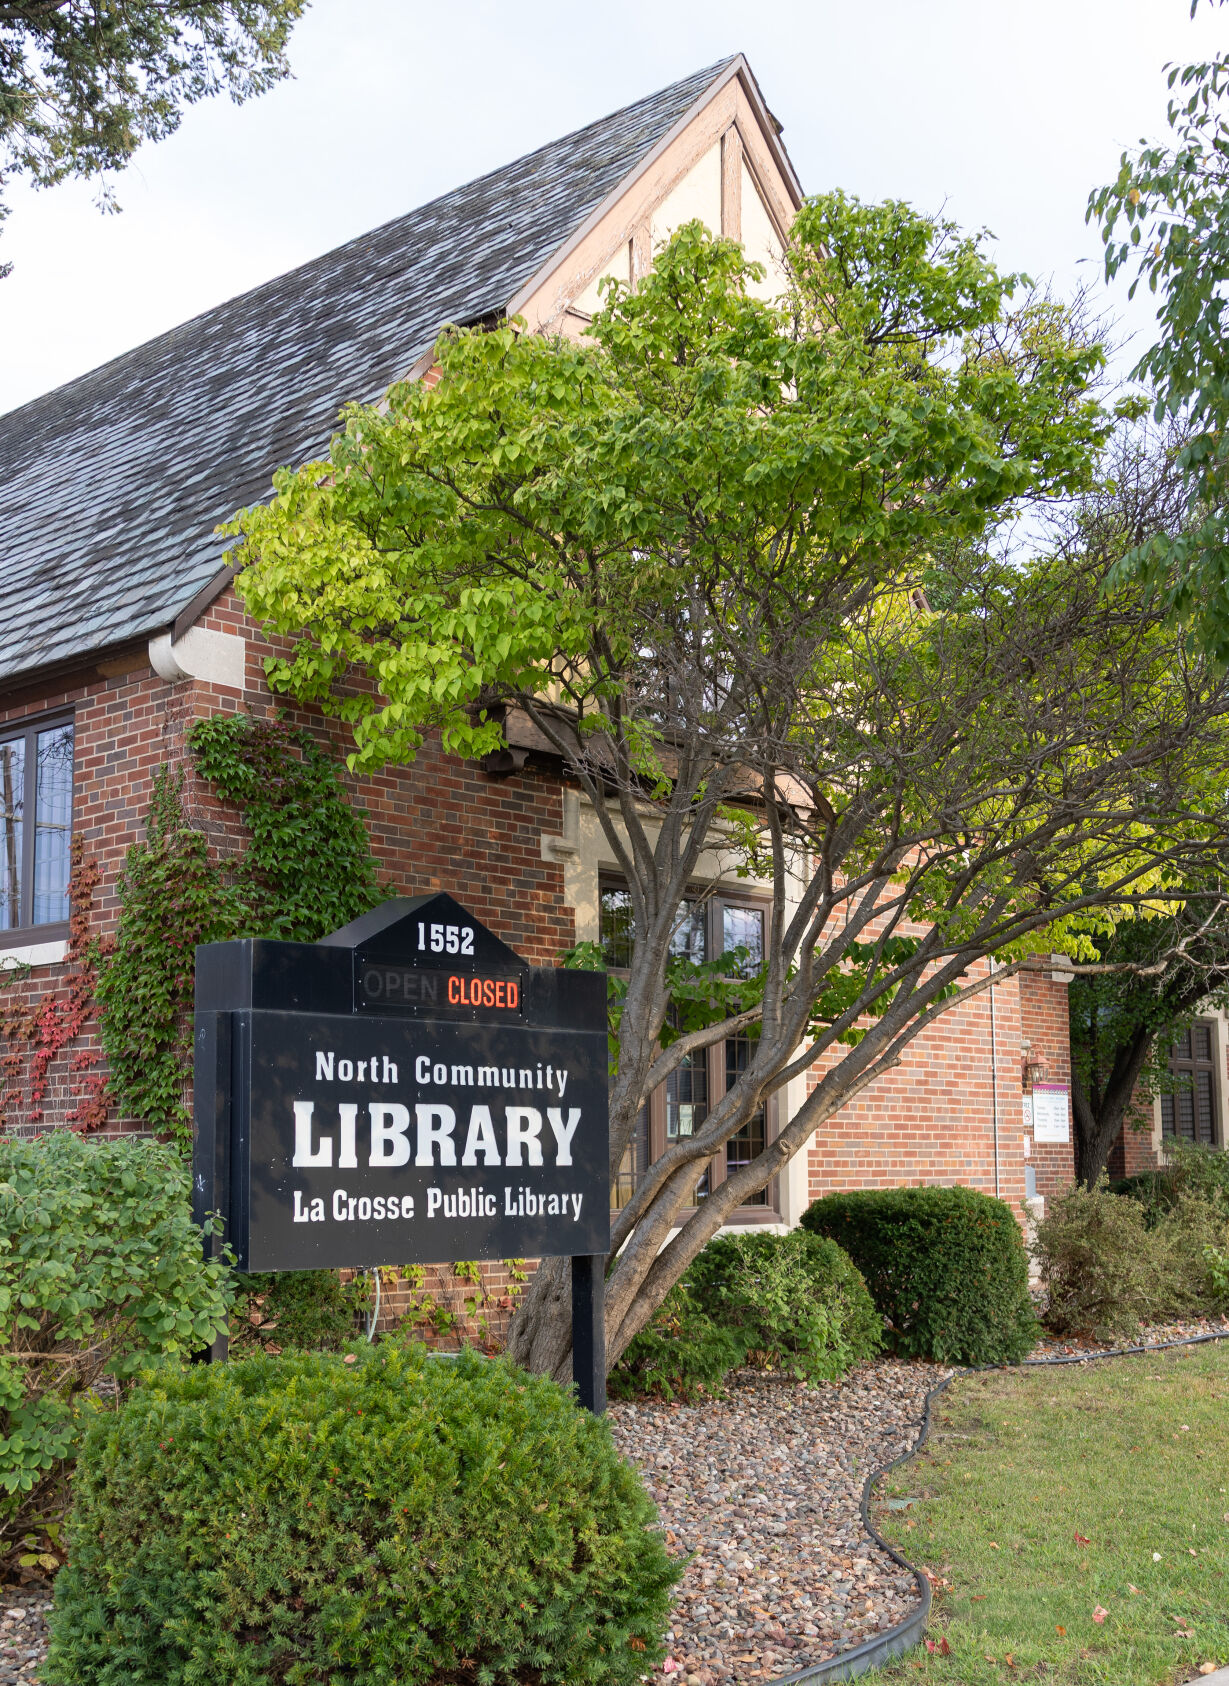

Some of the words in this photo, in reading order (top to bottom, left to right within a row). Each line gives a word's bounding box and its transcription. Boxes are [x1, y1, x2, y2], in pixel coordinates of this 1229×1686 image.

[418, 923, 474, 955] 1552
[364, 970, 436, 1000] OPEN
[448, 976, 518, 1008] CLOSED
[316, 1051, 398, 1083] North
[416, 1056, 568, 1097] Community
[292, 1101, 581, 1168] LIBRARY
[293, 1191, 325, 1222] La
[333, 1189, 414, 1221] Crosse
[427, 1187, 496, 1218] Public
[505, 1187, 583, 1221] Library
